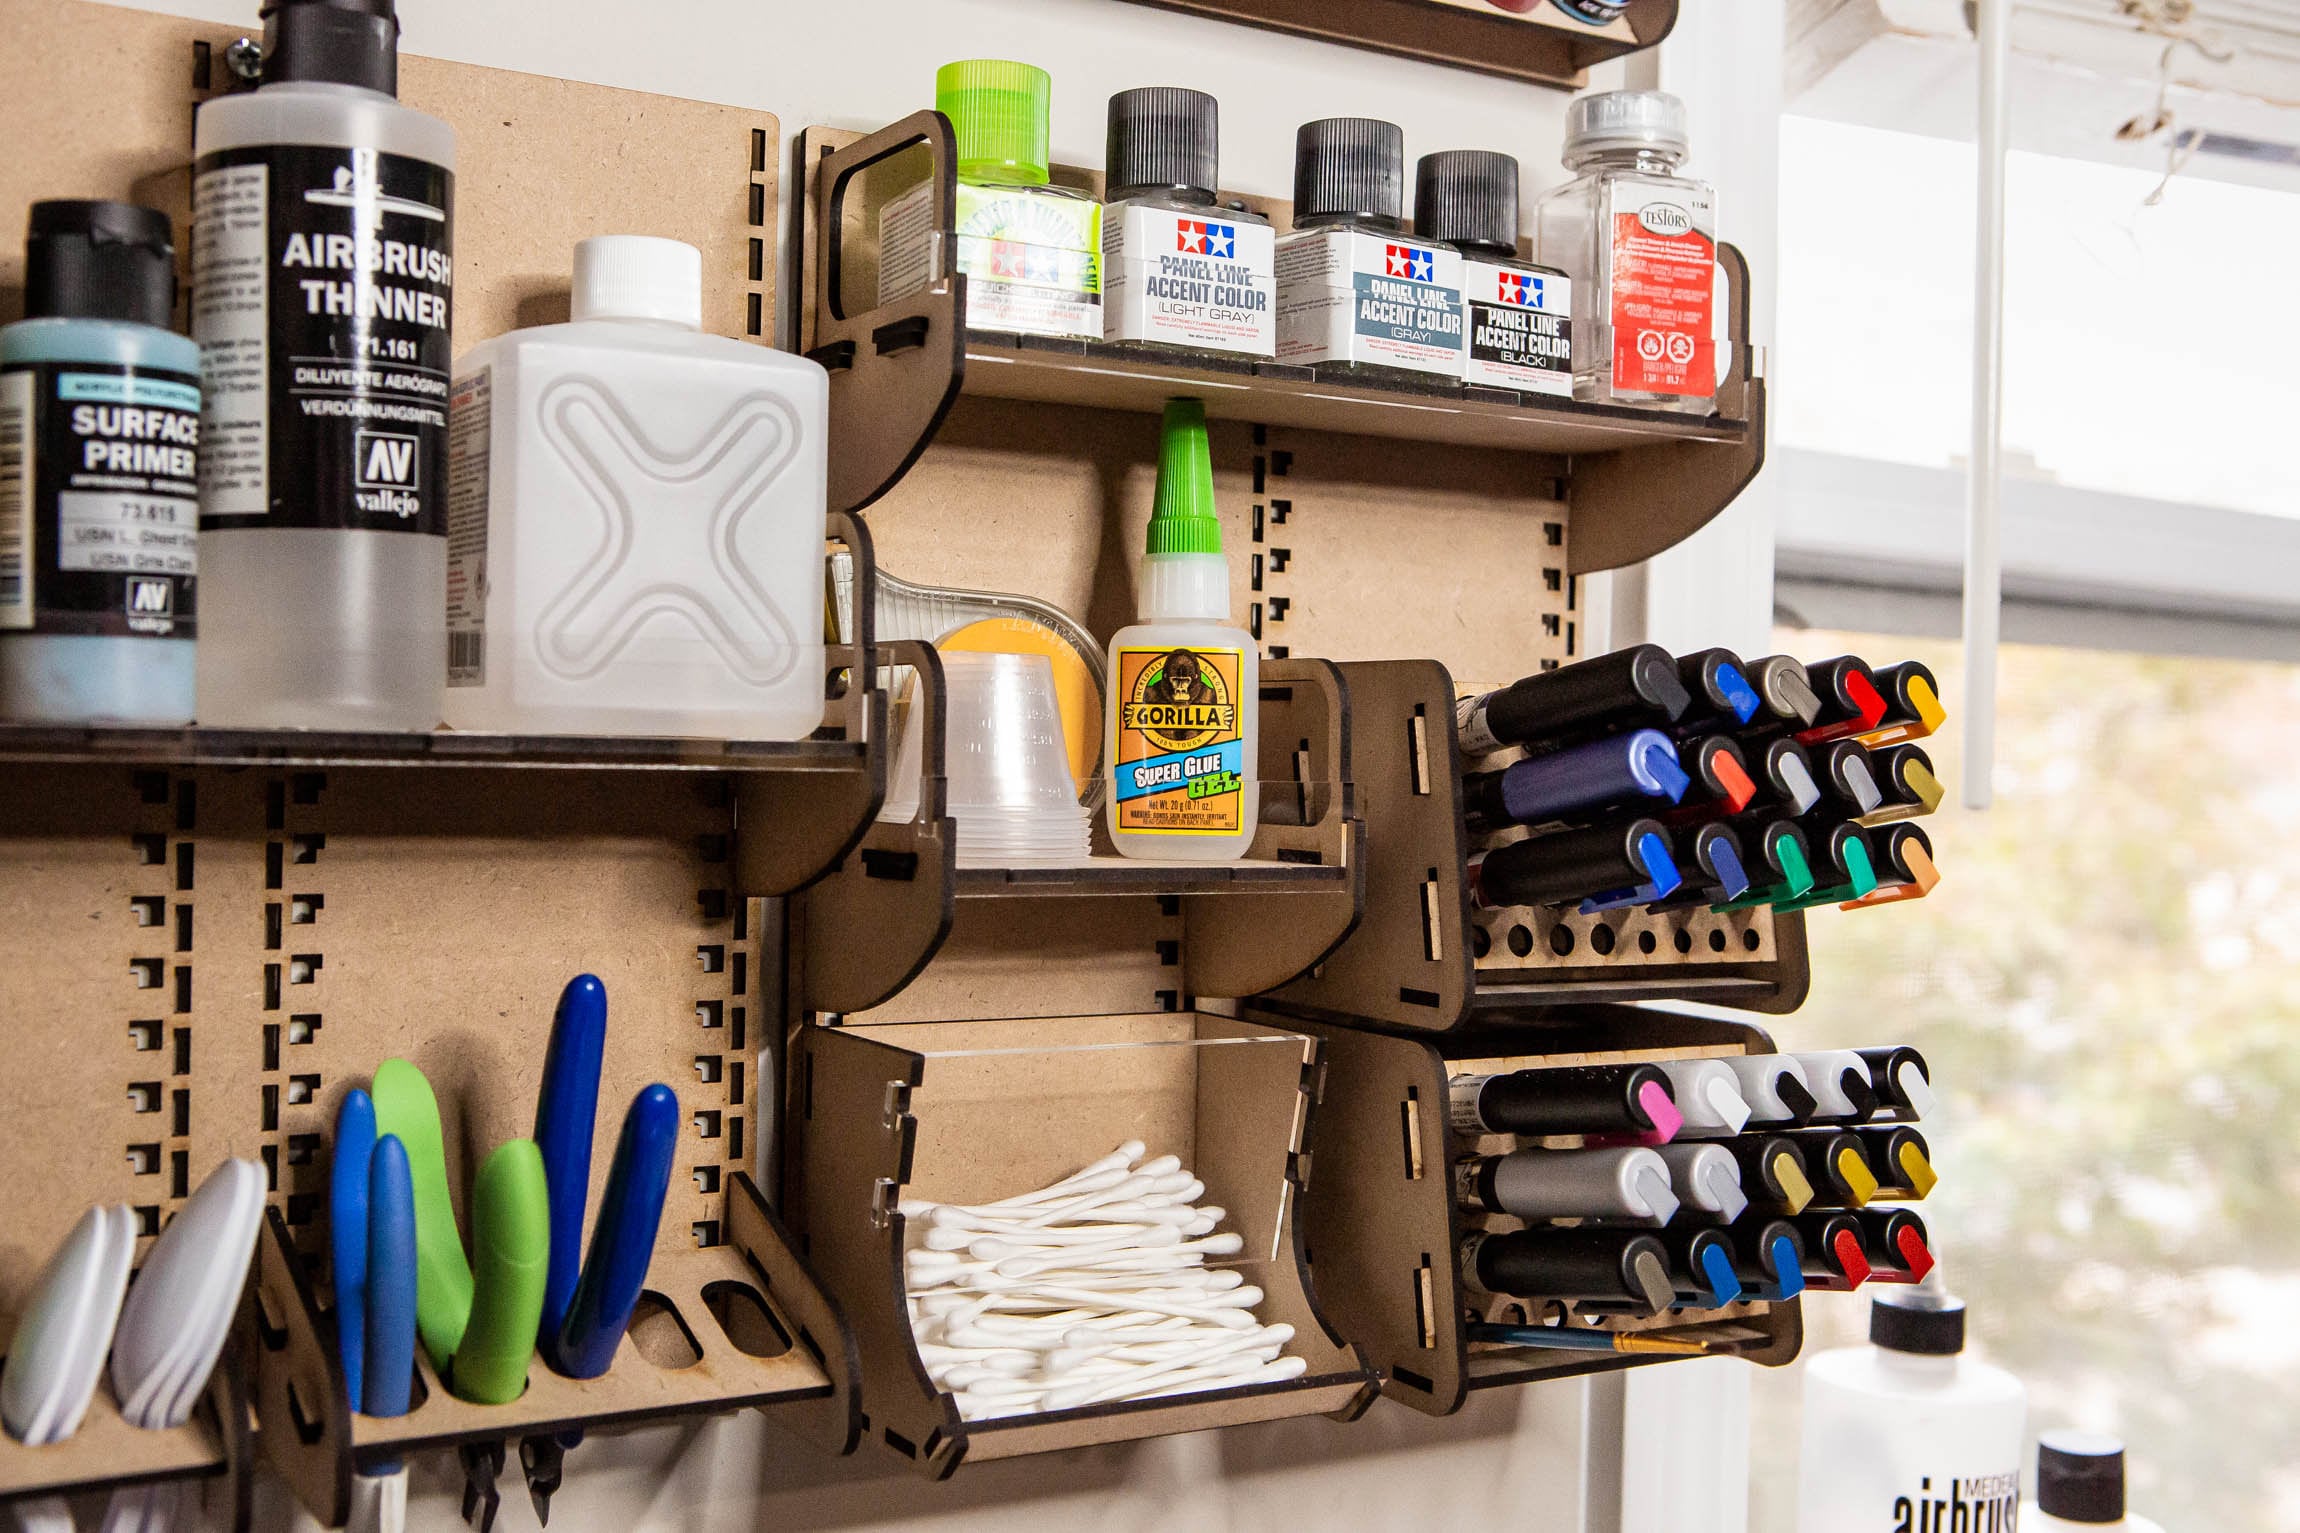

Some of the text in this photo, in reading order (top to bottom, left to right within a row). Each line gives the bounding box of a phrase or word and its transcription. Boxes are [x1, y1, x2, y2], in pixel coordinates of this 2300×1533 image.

[1645, 208, 1688, 228] TESTORS
[282, 232, 452, 287] AIRBRUSH
[1160, 255, 1253, 287] PANEL LINE
[299, 279, 447, 329] THNNER
[1147, 276, 1211, 304] ACCENT
[1214, 286, 1266, 311] COLOR
[1371, 279, 1450, 311] PANEL LINE
[1158, 301, 1255, 324] (LIGHT GRAY)
[1360, 299, 1415, 327] ACCENT
[1417, 308, 1460, 335] COLOR
[1488, 309, 1560, 337] PANEL LINE
[357, 336, 417, 360] 71.161
[1391, 327, 1432, 344] (GRAY)
[1475, 325, 1570, 359] ACCENT COLOR
[1501, 350, 1546, 367] (BLACK)
[295, 367, 383, 388] DILUYENTE
[72, 404, 199, 446] SURFACE
[84, 440, 196, 478] PRIMER
[365, 439, 413, 483] AV
[355, 490, 420, 519] vallejo
[1137, 706, 1220, 726] GORILLA
[1188, 771, 1241, 799] GEL
